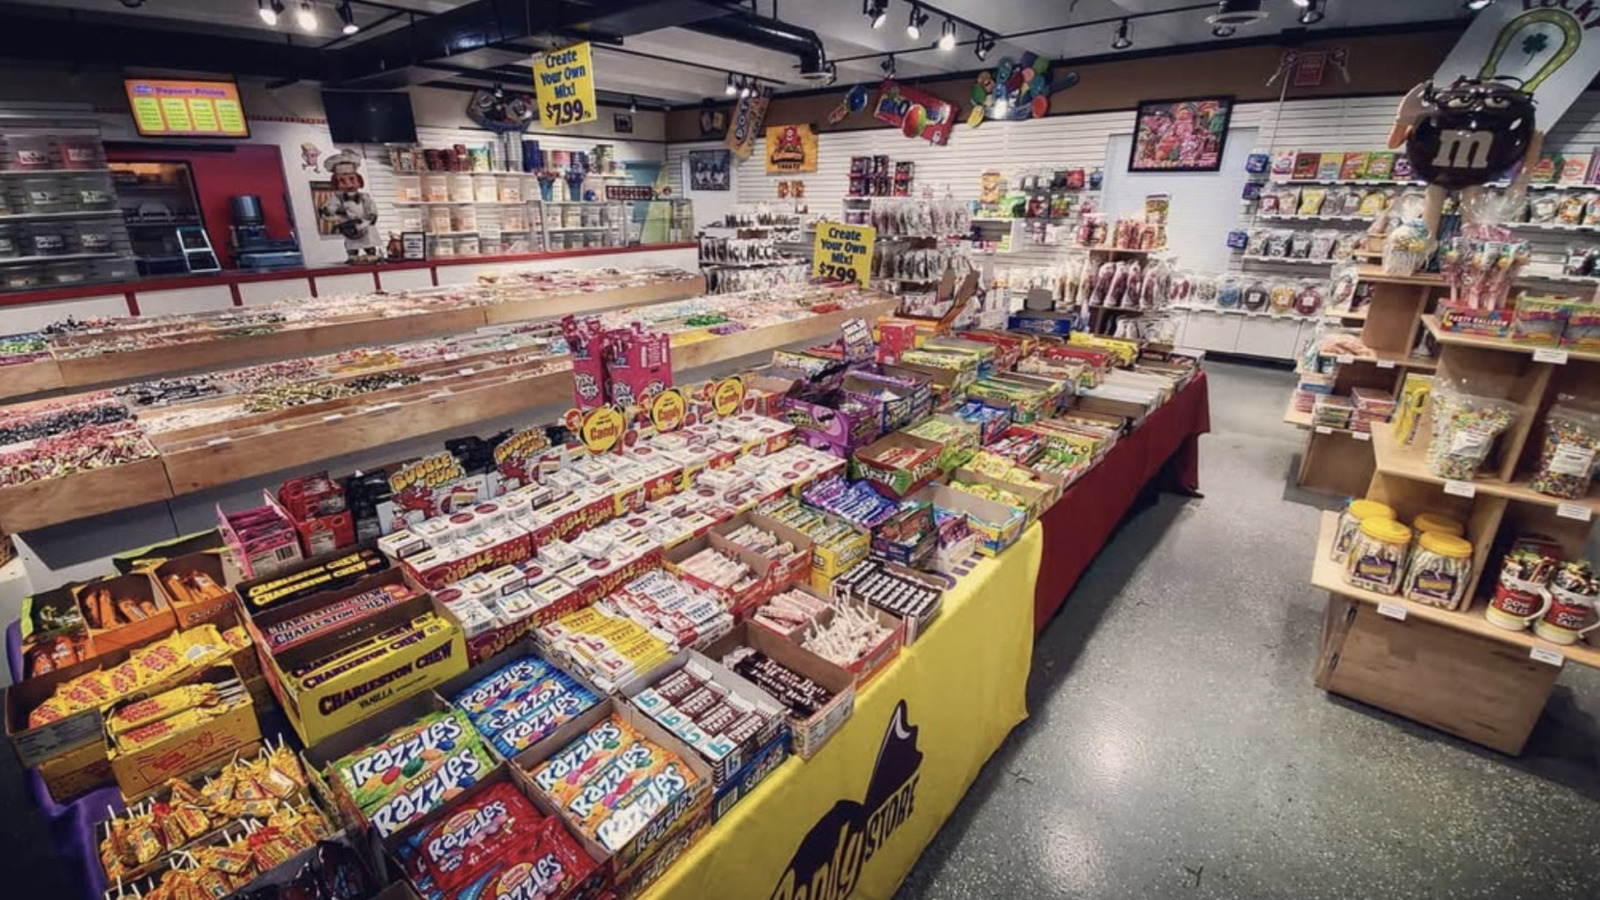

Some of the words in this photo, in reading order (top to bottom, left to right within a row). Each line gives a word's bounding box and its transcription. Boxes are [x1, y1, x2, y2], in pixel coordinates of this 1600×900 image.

[540, 71, 562, 86] Your
[564, 65, 586, 80] Own
[545, 50, 577, 68] Create
[1432, 130, 1494, 169] m
[821, 239, 843, 251] Your
[844, 242, 867, 254] Own
[828, 228, 862, 242] Create
[589, 425, 619, 442] Candy
[392, 454, 452, 492] BUBBLE
[426, 467, 460, 489] GUM
[274, 609, 355, 645] CHARLESTON
[357, 592, 393, 612] CHEW
[302, 647, 389, 689] CHARLESTON
[389, 630, 427, 650] CHEW
[318, 662, 414, 717] CHARLESTON
[415, 640, 454, 670] CHEW
[357, 687, 394, 710] VANILLA
[460, 661, 534, 712] Razzles
[501, 691, 581, 748] Razzles
[708, 710, 734, 734] TAFFY
[738, 720, 764, 744] TAFFY
[352, 715, 463, 788] Razzles
[534, 721, 622, 792] Razzles
[371, 748, 481, 839] Razzles
[568, 741, 652, 819] Razzles
[428, 800, 508, 863] Razzles
[864, 773, 922, 863] STORE
